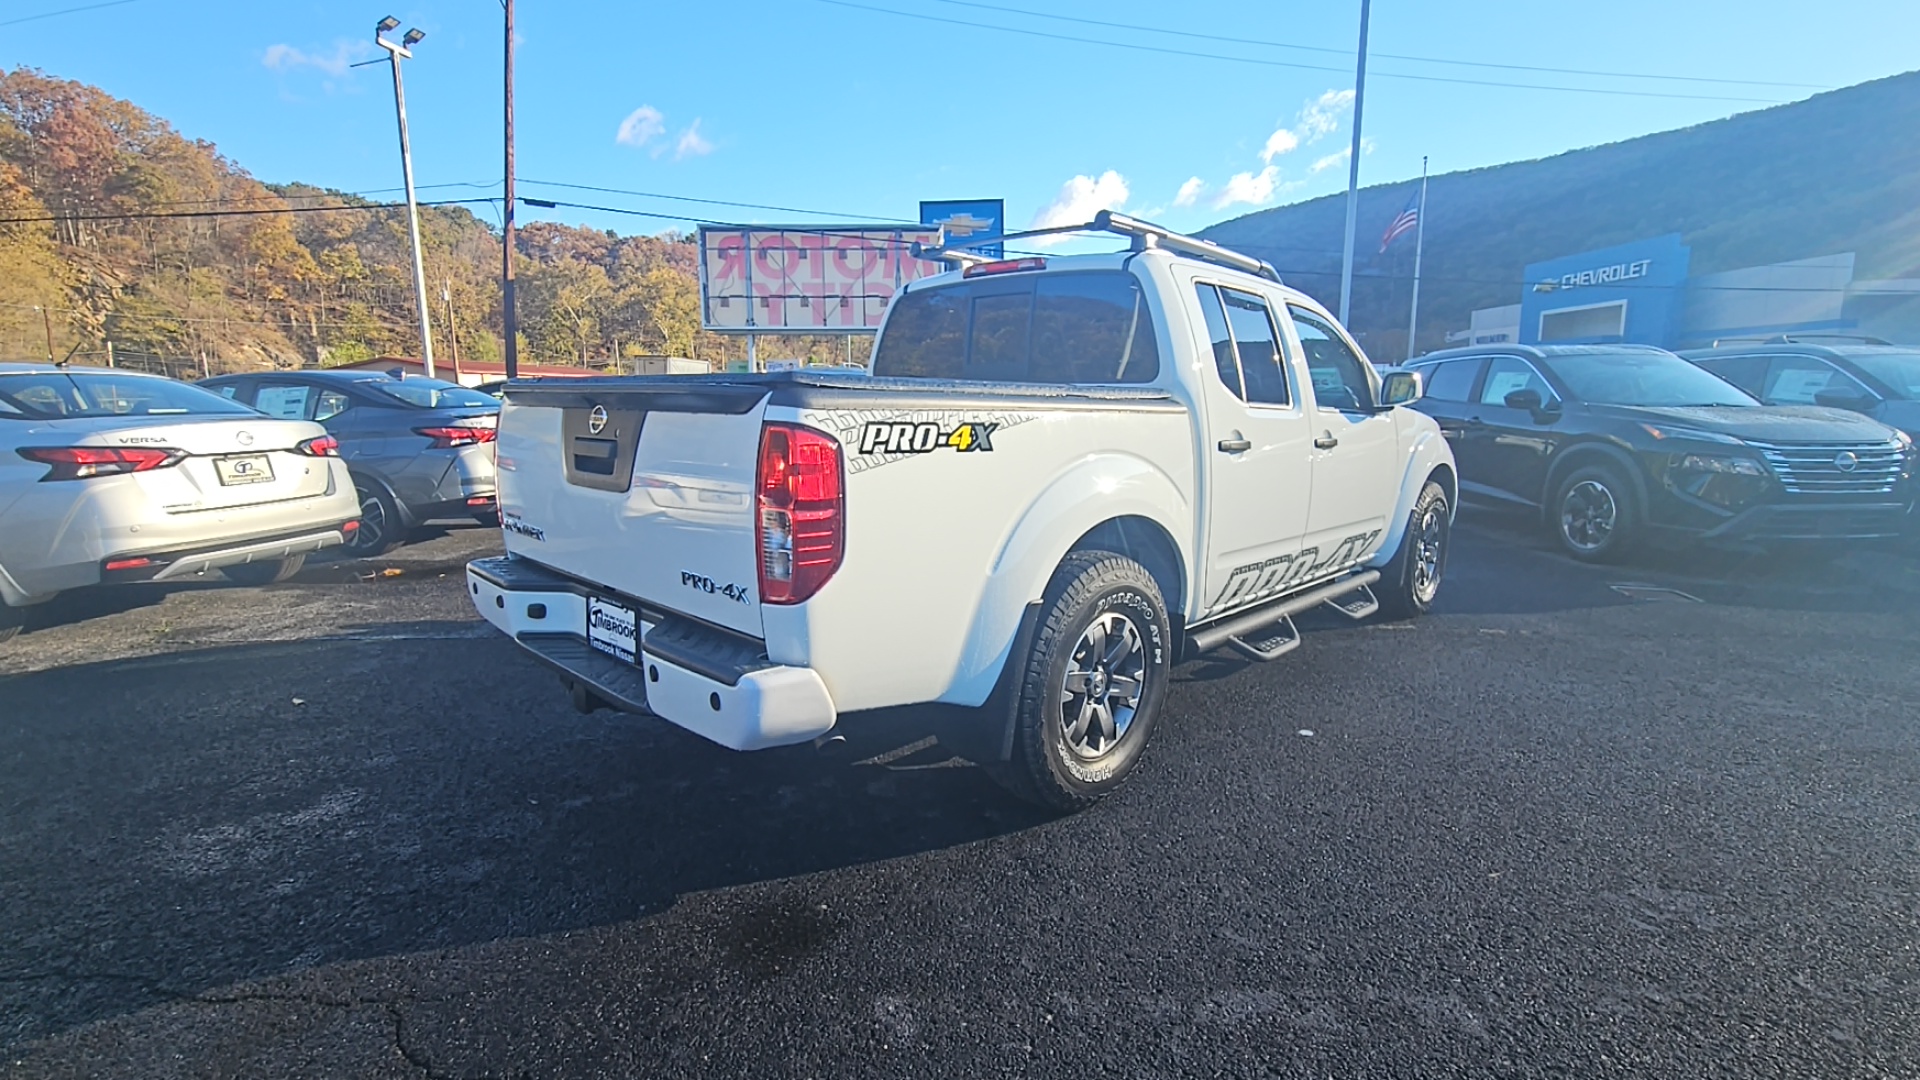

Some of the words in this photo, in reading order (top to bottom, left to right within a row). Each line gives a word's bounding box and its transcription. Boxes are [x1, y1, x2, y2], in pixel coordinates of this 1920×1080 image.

[1561, 259, 1651, 289] CHEVROLET
[859, 422, 1000, 454] PRO-4X
[681, 570, 751, 605] PRO-4X
[590, 607, 637, 641] TIMBROOK
